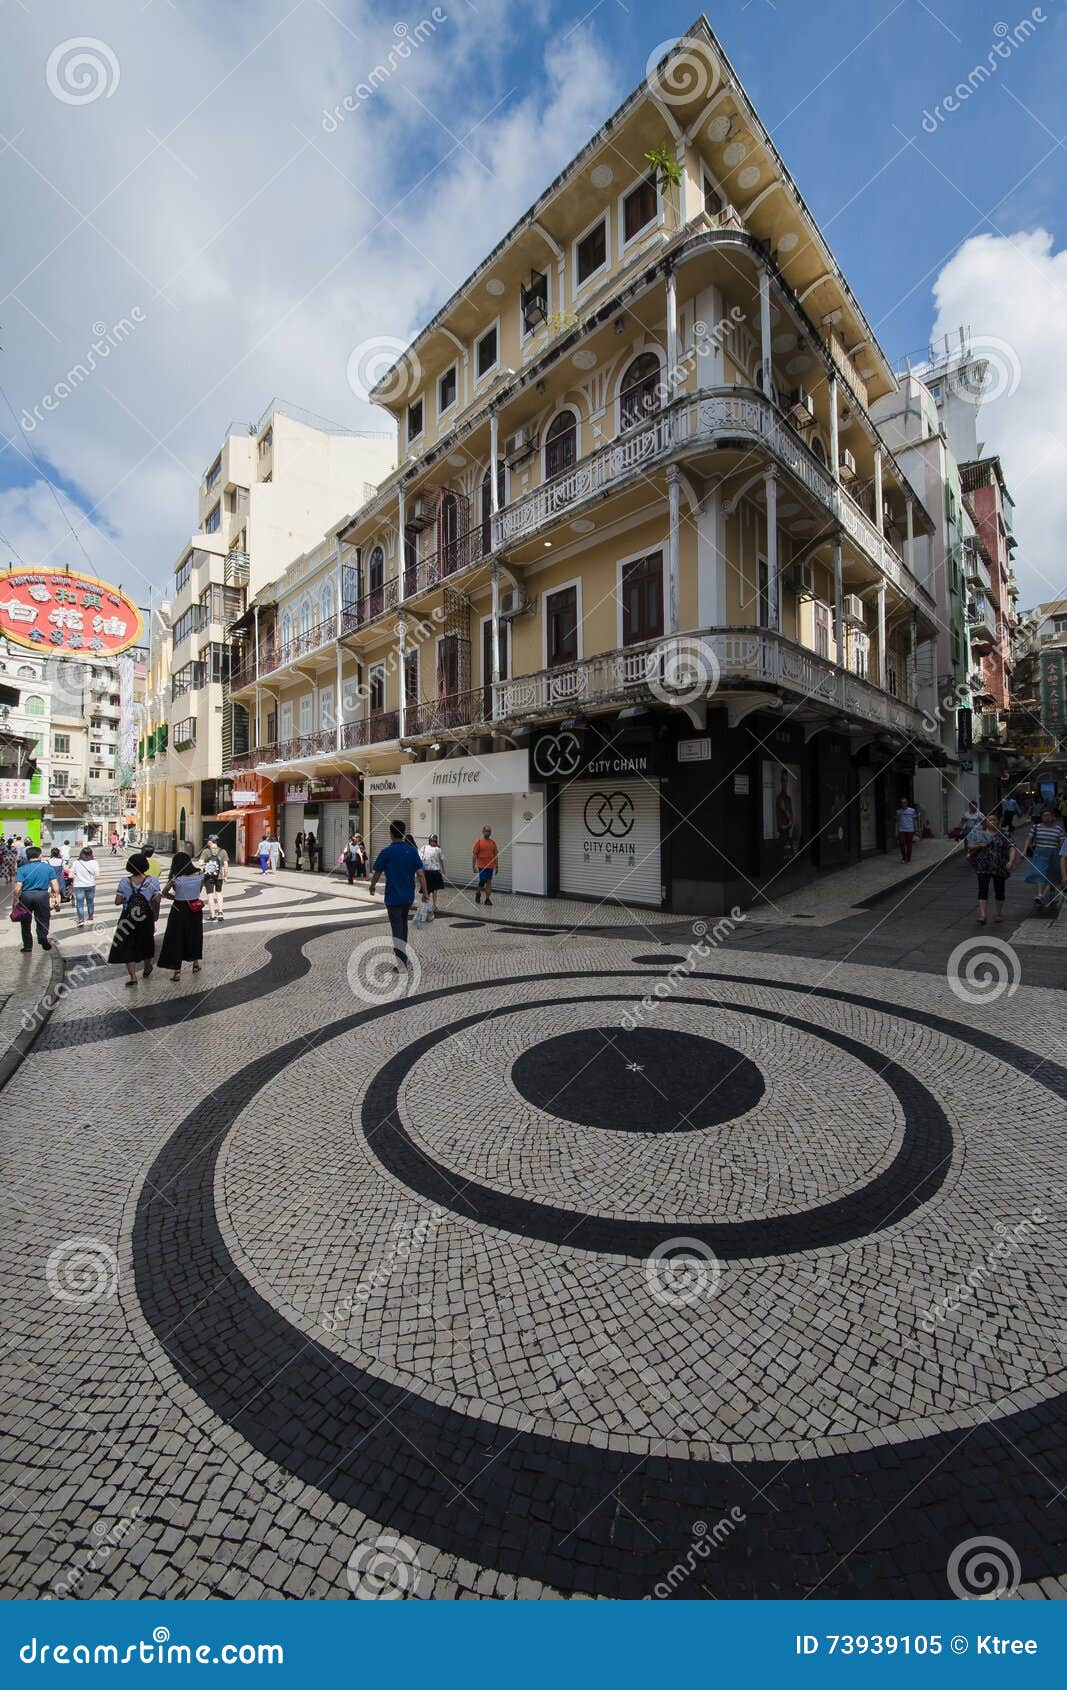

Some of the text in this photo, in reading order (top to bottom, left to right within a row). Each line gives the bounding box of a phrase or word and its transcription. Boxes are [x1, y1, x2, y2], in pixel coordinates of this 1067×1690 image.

[588, 757, 647, 773] CITY CHAIN
[432, 766, 481, 788] innisfree
[583, 841, 635, 854] CITY CHAIN
